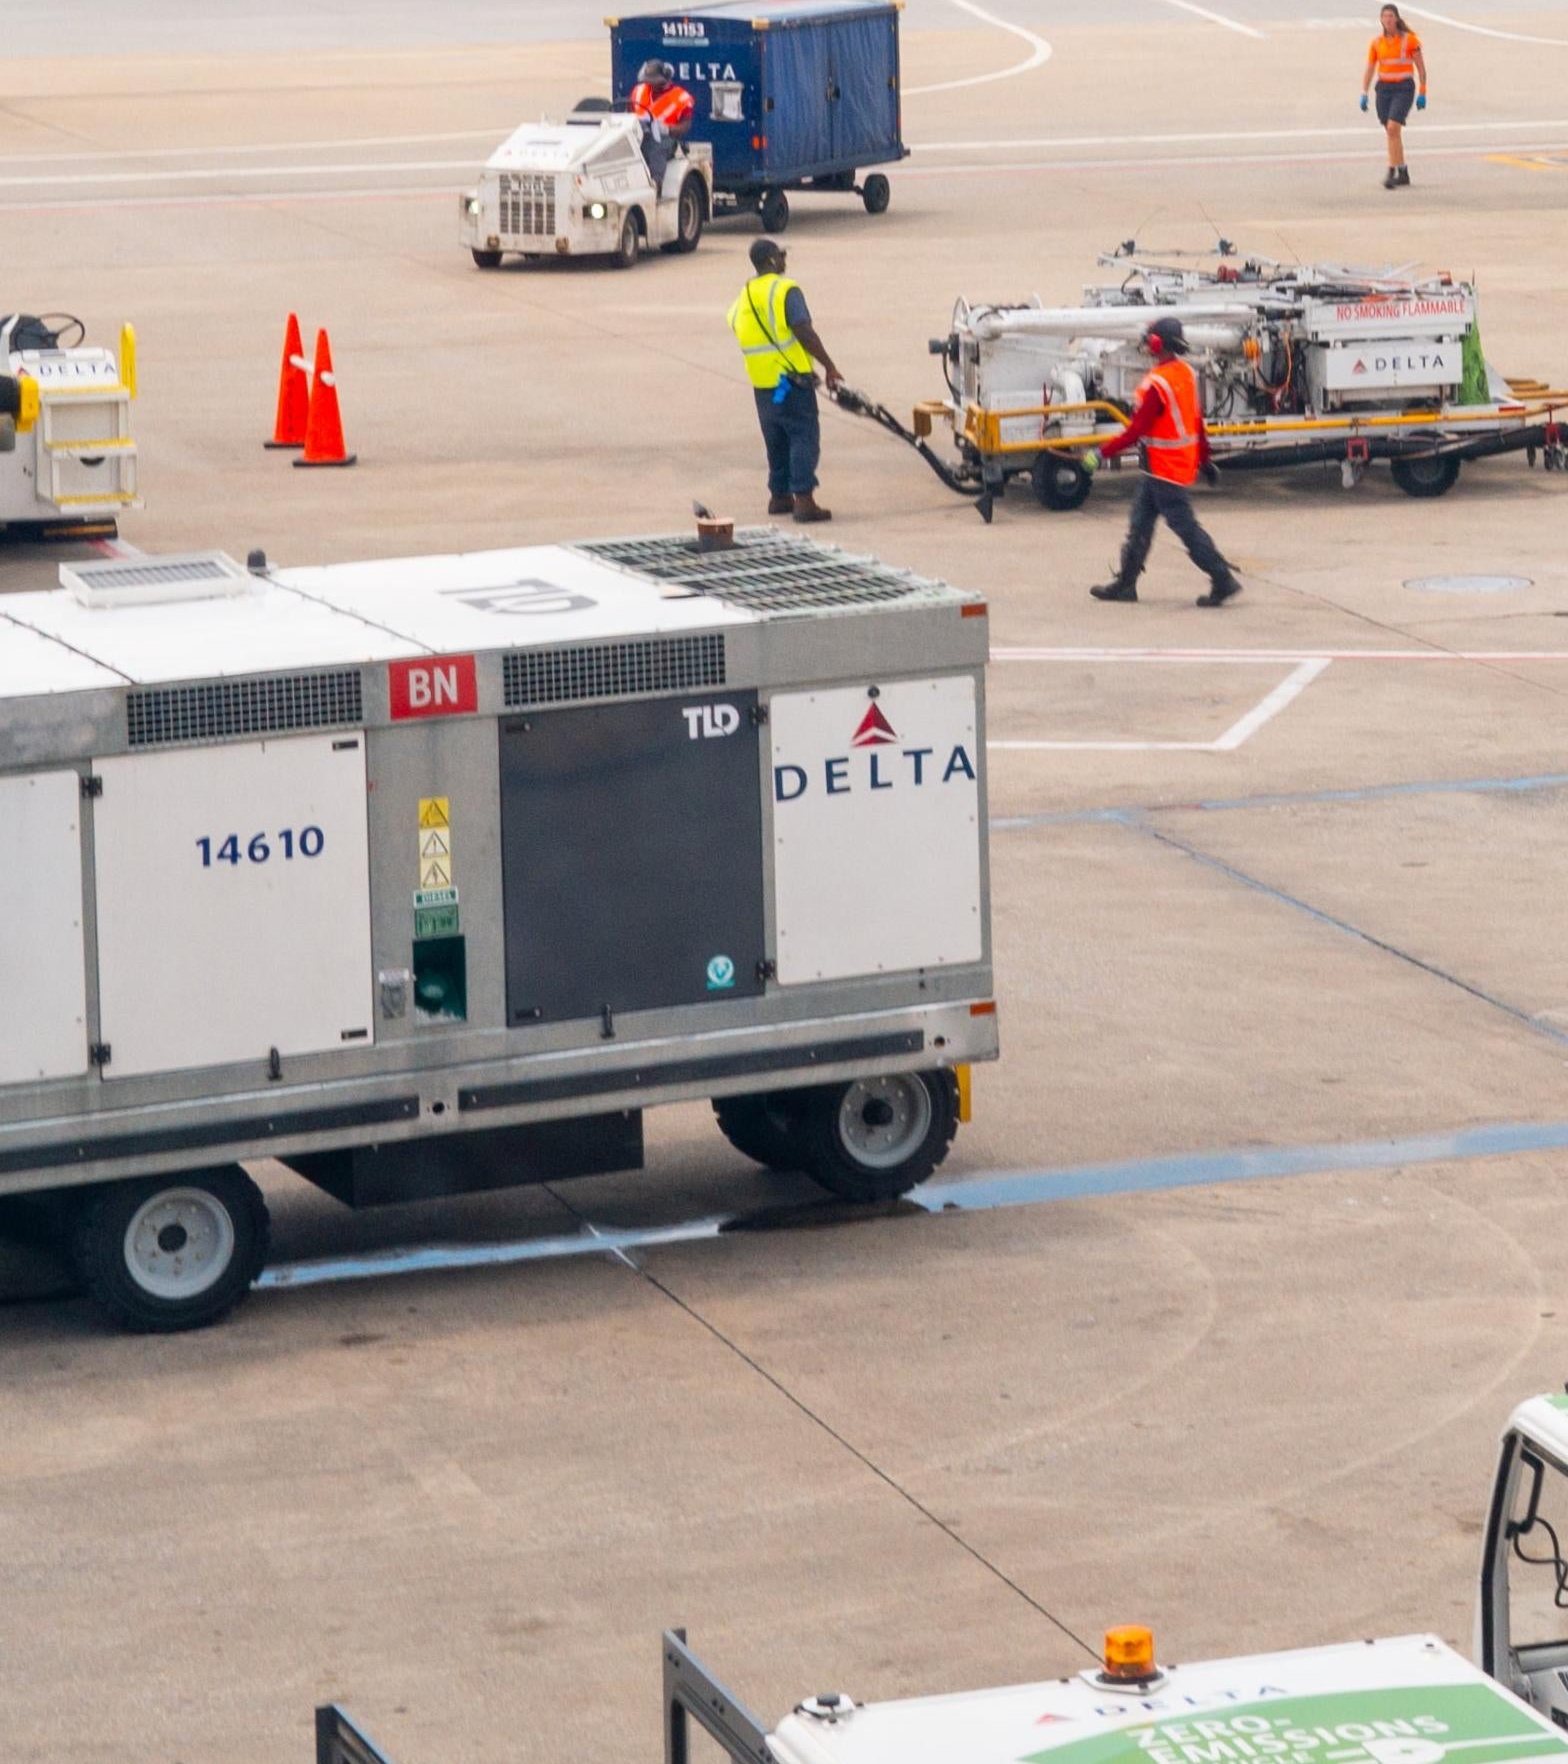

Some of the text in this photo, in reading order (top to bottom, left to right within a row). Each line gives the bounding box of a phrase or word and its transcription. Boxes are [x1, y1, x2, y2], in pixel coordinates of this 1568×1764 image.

[662, 22, 704, 37] 141153
[1336, 299, 1465, 320] NO SMOKING FLAMMABLE
[39, 363, 117, 376] DELTA
[1375, 356, 1444, 371] DELTA
[408, 665, 458, 709] BN
[682, 703, 740, 740] TLD
[774, 744, 977, 803] DELTA
[195, 826, 325, 869] 14610
[1093, 1684, 1288, 1717] DELTA
[1127, 1715, 1292, 1749] ZERO-
[1146, 1714, 1450, 1764] EMISSIONS
